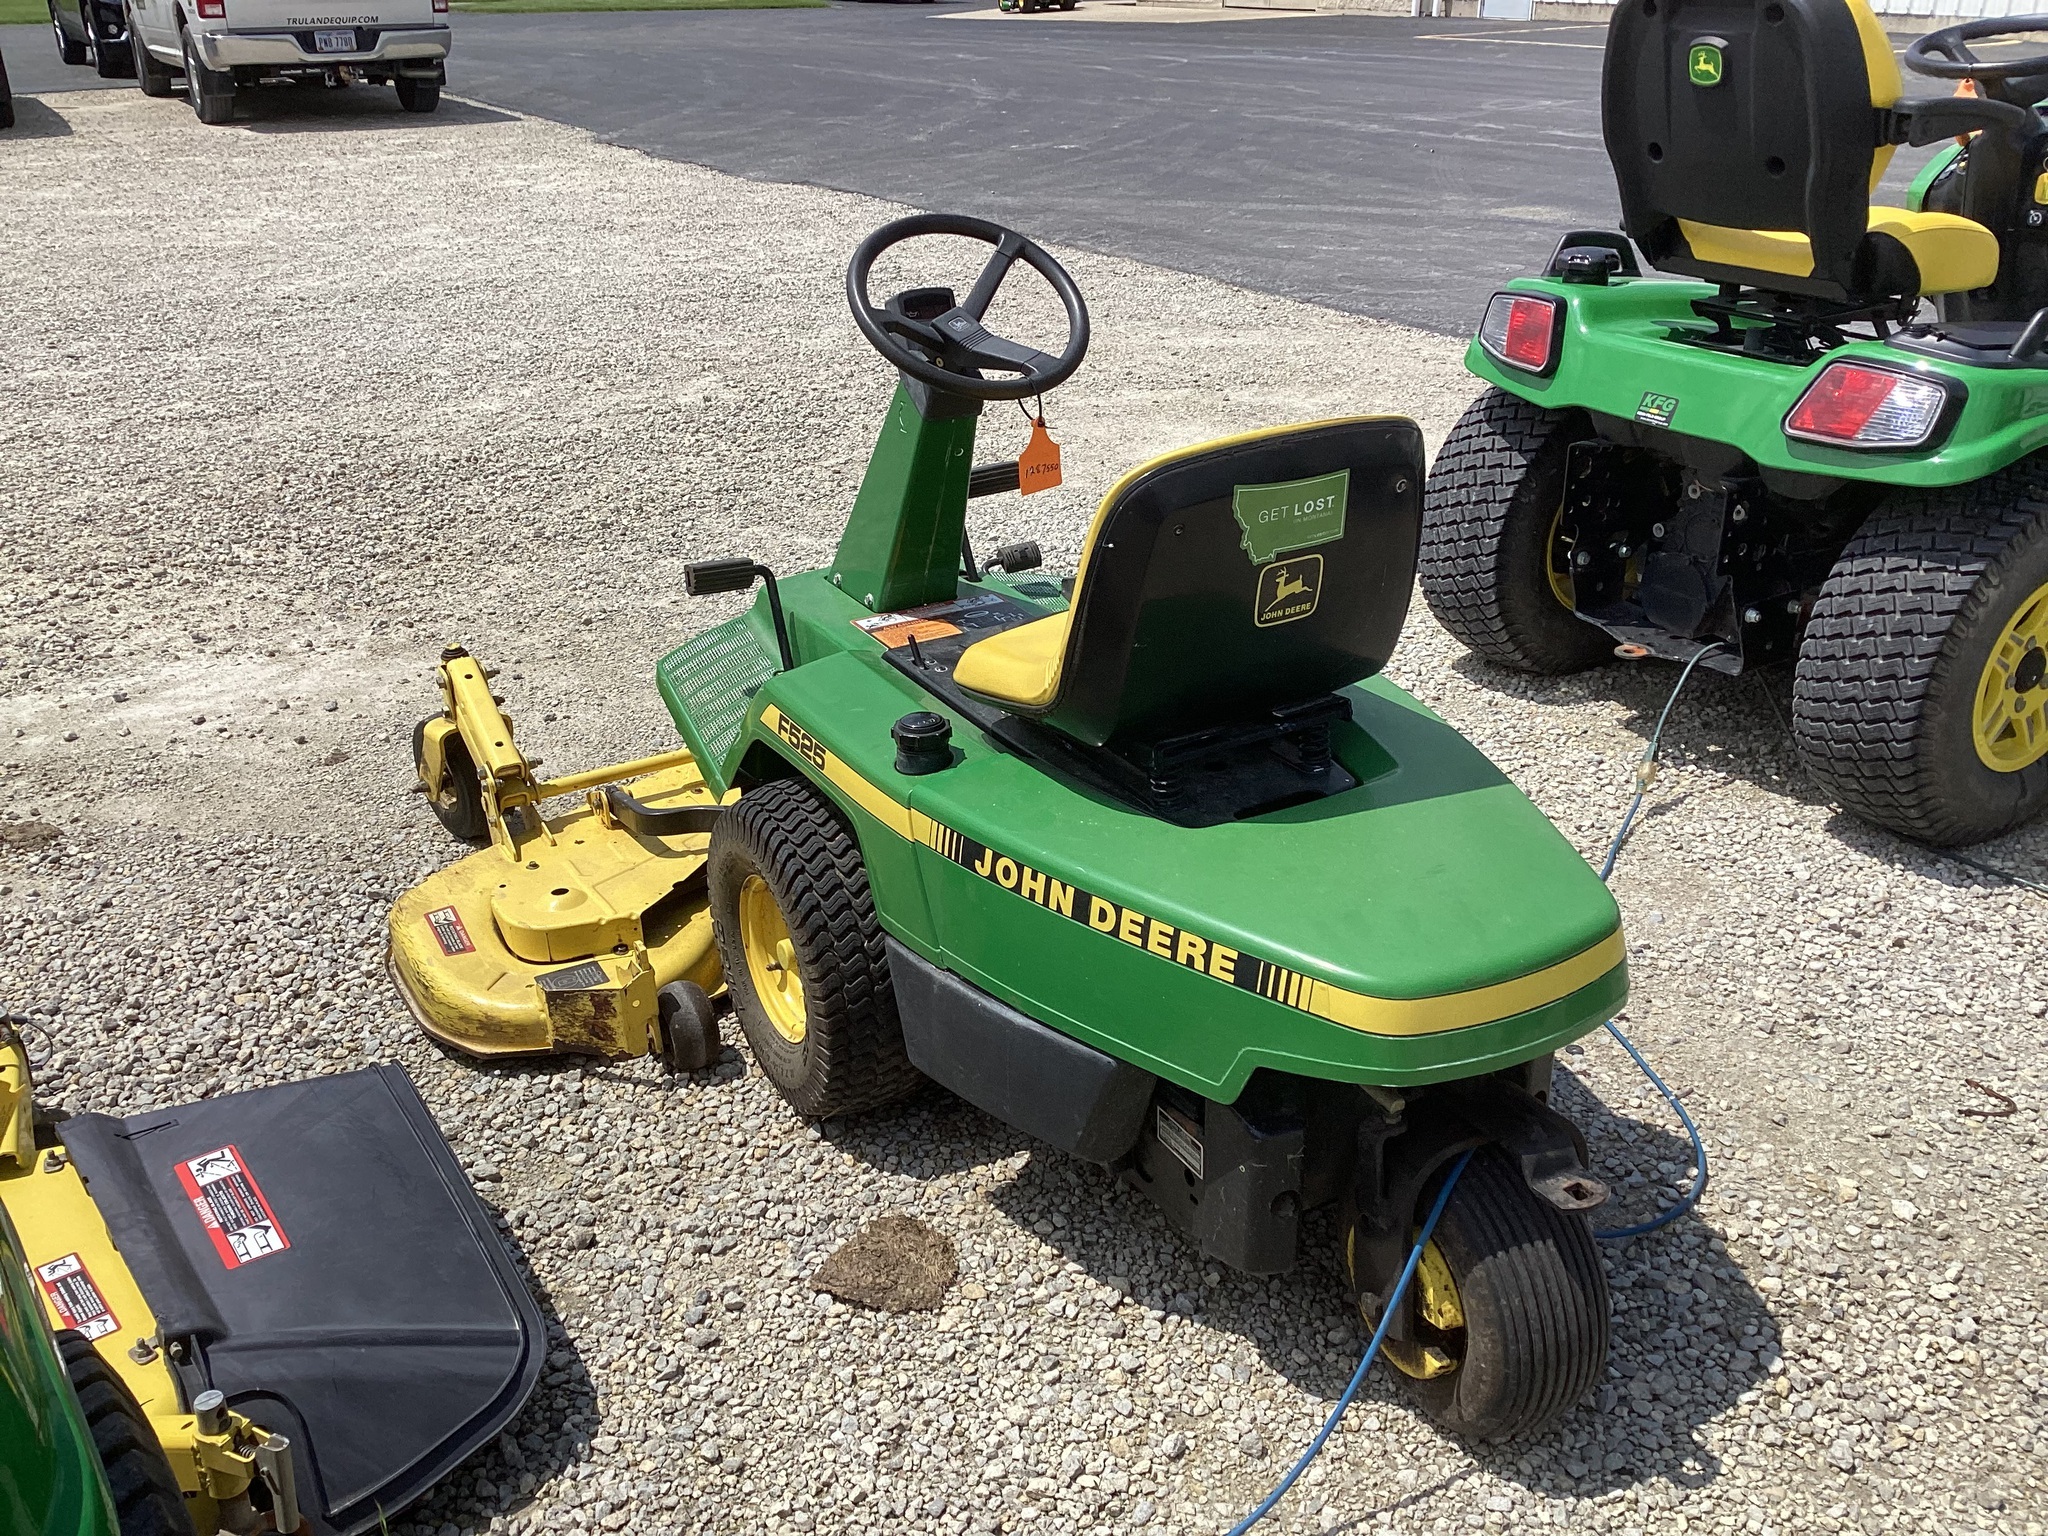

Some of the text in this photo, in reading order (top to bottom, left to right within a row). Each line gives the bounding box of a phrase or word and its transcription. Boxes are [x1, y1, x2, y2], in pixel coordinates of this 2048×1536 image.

[287, 16, 379, 25] TRULANDEQUIP.COM
[1642, 394, 1676, 411] KFG
[1258, 506, 1289, 523] GET
[1261, 602, 1311, 621] JOHN DEERE
[778, 712, 826, 771] F525
[975, 848, 1239, 983] JOHN DEERE
[193, 1195, 215, 1224] DANGER
[50, 1291, 68, 1313] DANGER
